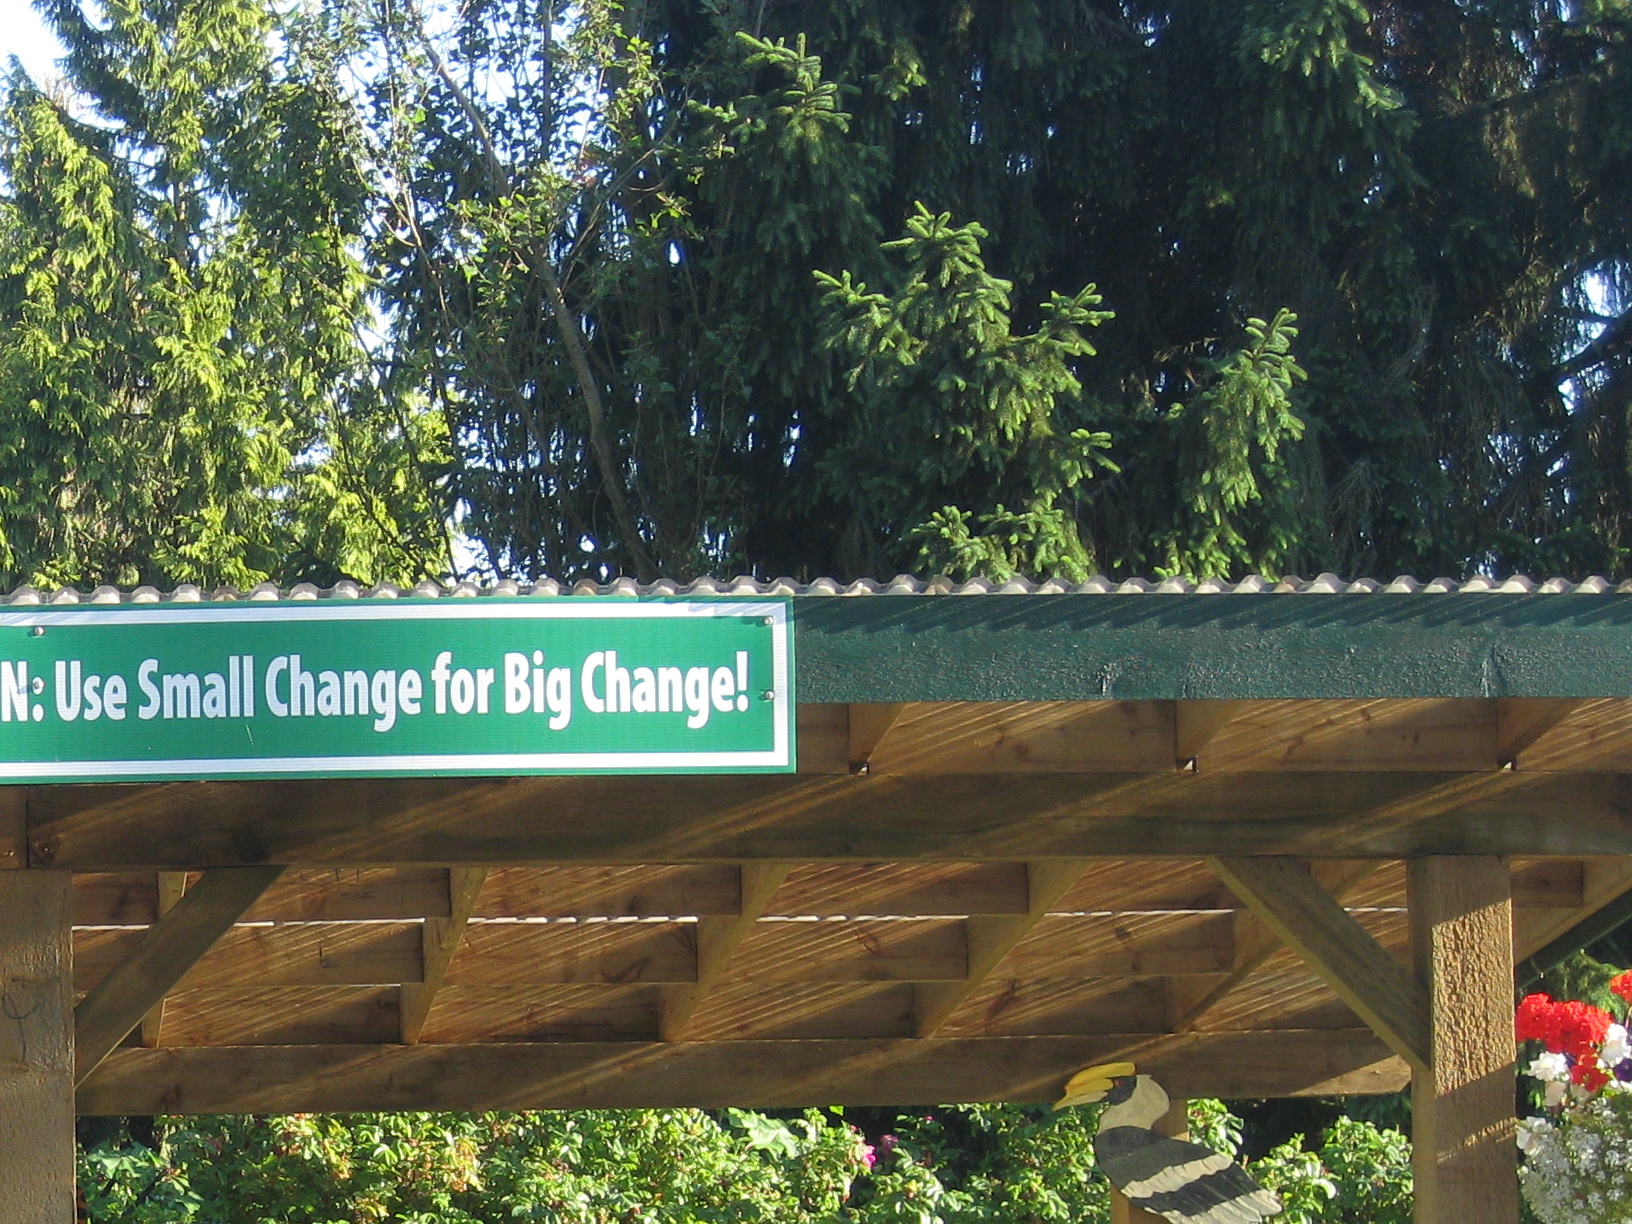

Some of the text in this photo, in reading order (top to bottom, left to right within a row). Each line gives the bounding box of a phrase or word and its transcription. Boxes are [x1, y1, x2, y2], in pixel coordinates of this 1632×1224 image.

[54, 660, 128, 722] Use
[137, 655, 255, 720] Small
[265, 654, 423, 733] Change
[430, 650, 495, 715] for
[503, 649, 574, 731] Big
[580, 649, 750, 730] Change!
